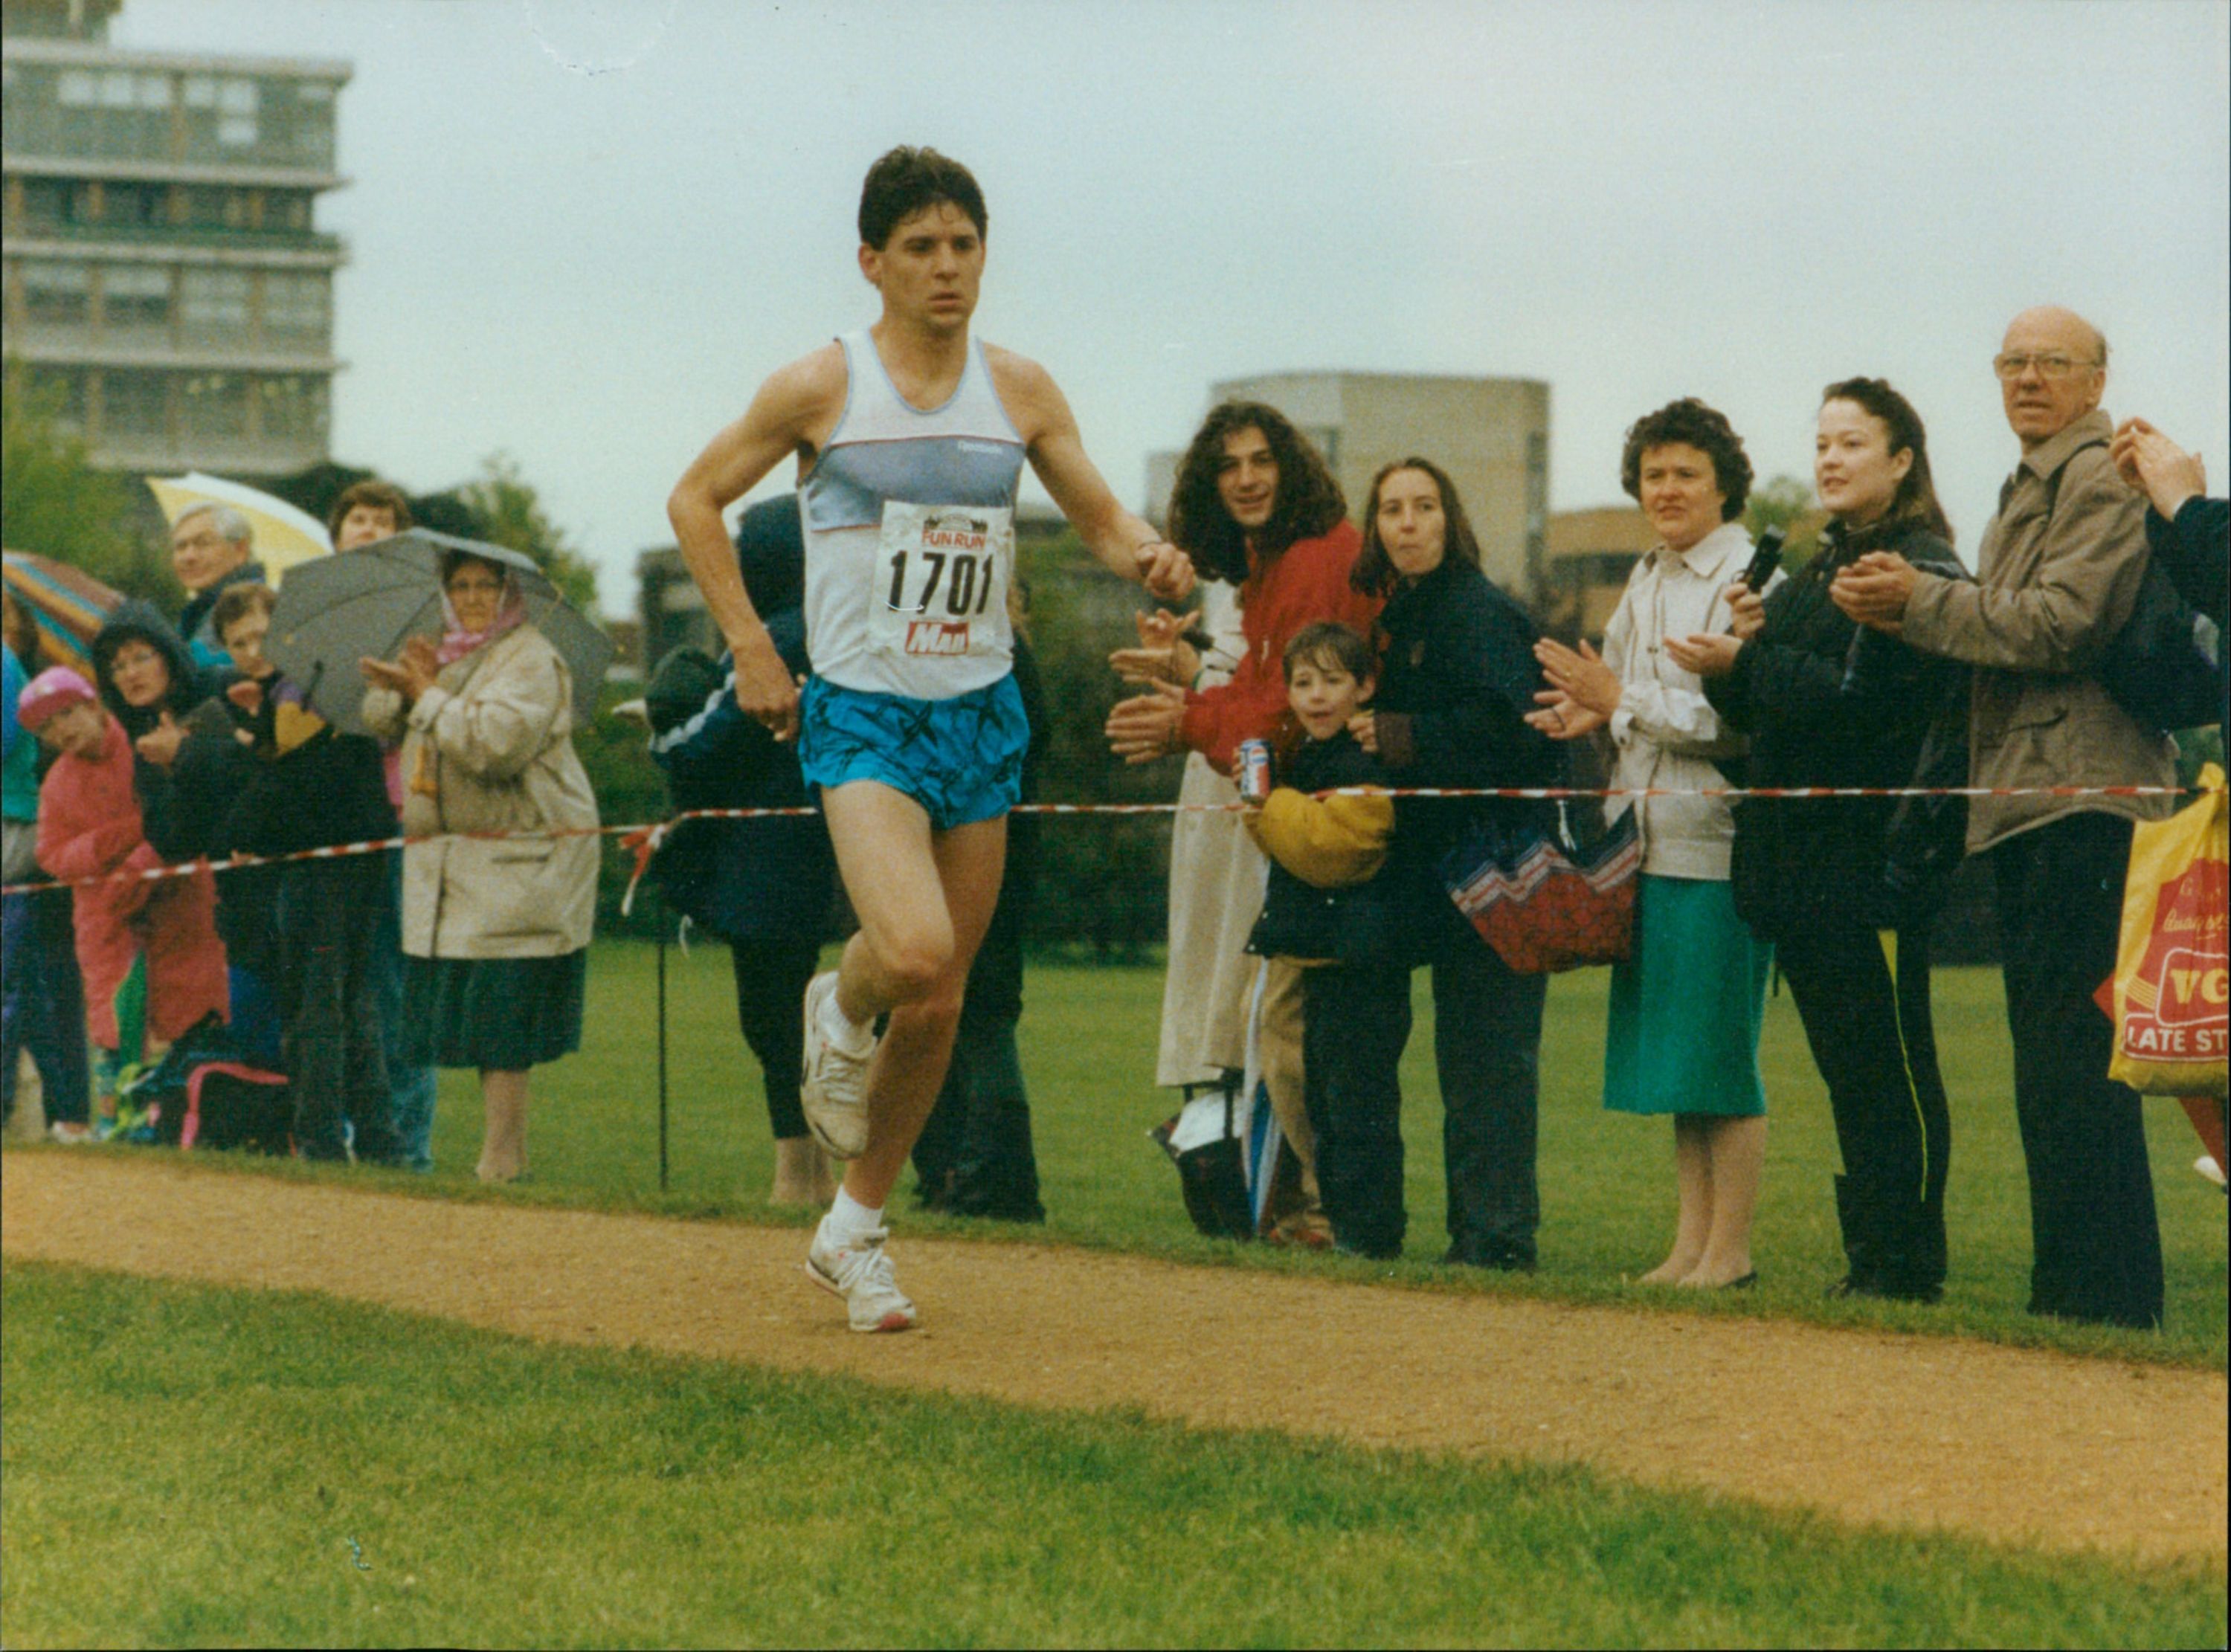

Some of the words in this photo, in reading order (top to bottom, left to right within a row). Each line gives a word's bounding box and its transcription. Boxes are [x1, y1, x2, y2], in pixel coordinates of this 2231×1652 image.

[921, 528, 952, 546] FUN
[954, 531, 986, 549] RUN
[888, 549, 994, 616] 1701
[2170, 968, 2228, 1004] VG
[2127, 1026, 2186, 1053] LATE
[2195, 1028, 2228, 1052] ST
